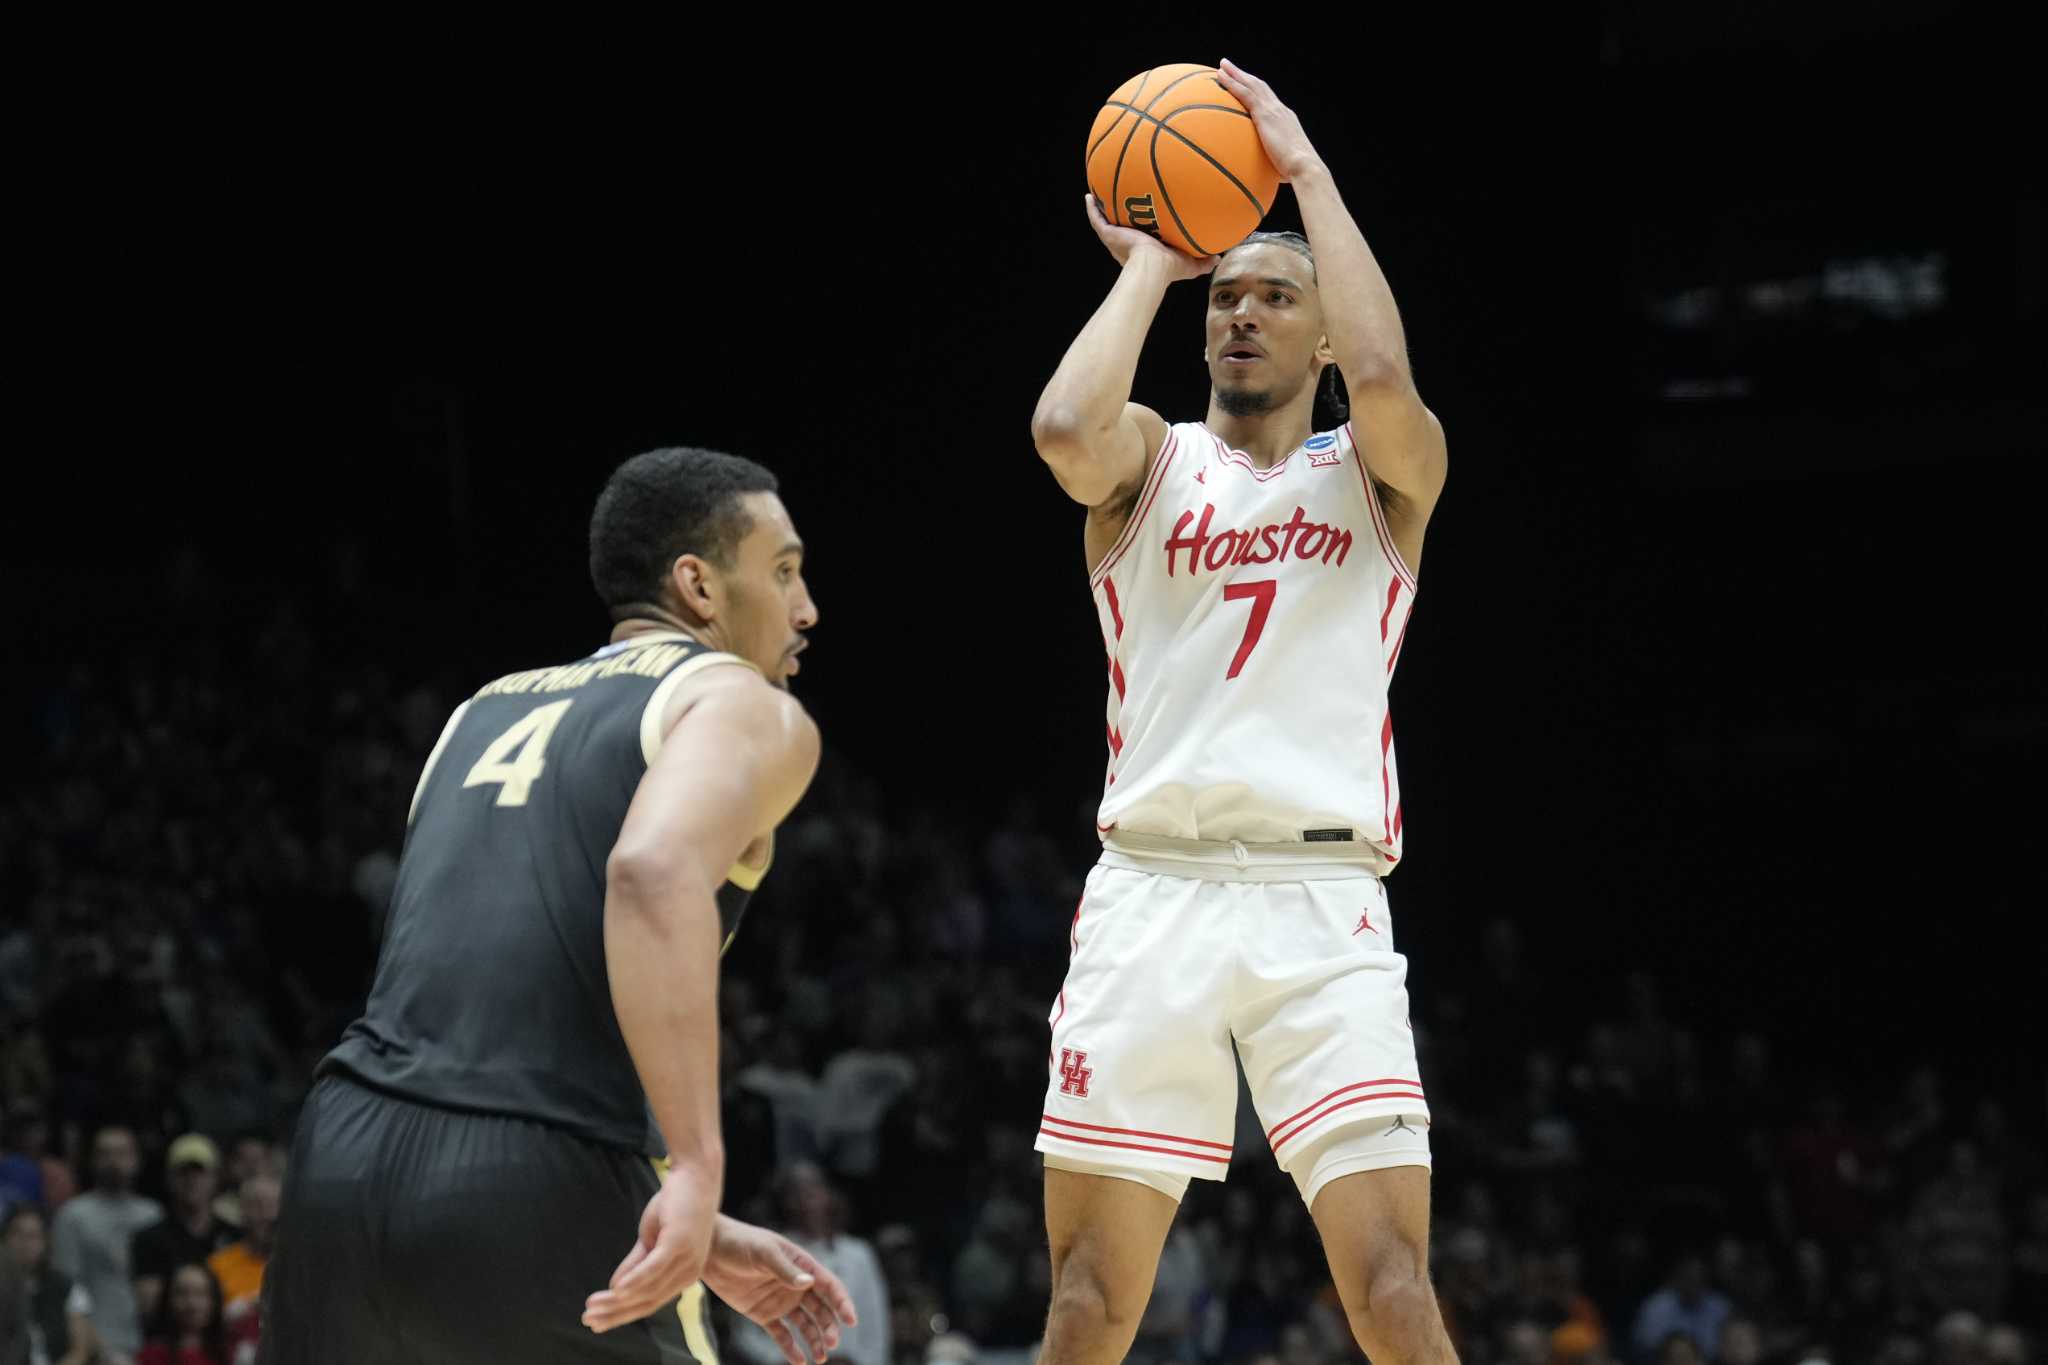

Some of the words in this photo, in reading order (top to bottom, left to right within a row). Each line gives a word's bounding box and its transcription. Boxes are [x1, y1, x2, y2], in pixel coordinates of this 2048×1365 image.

[1164, 502, 1352, 577] Houston
[1224, 580, 1276, 681] 7
[462, 698, 574, 807] 4
